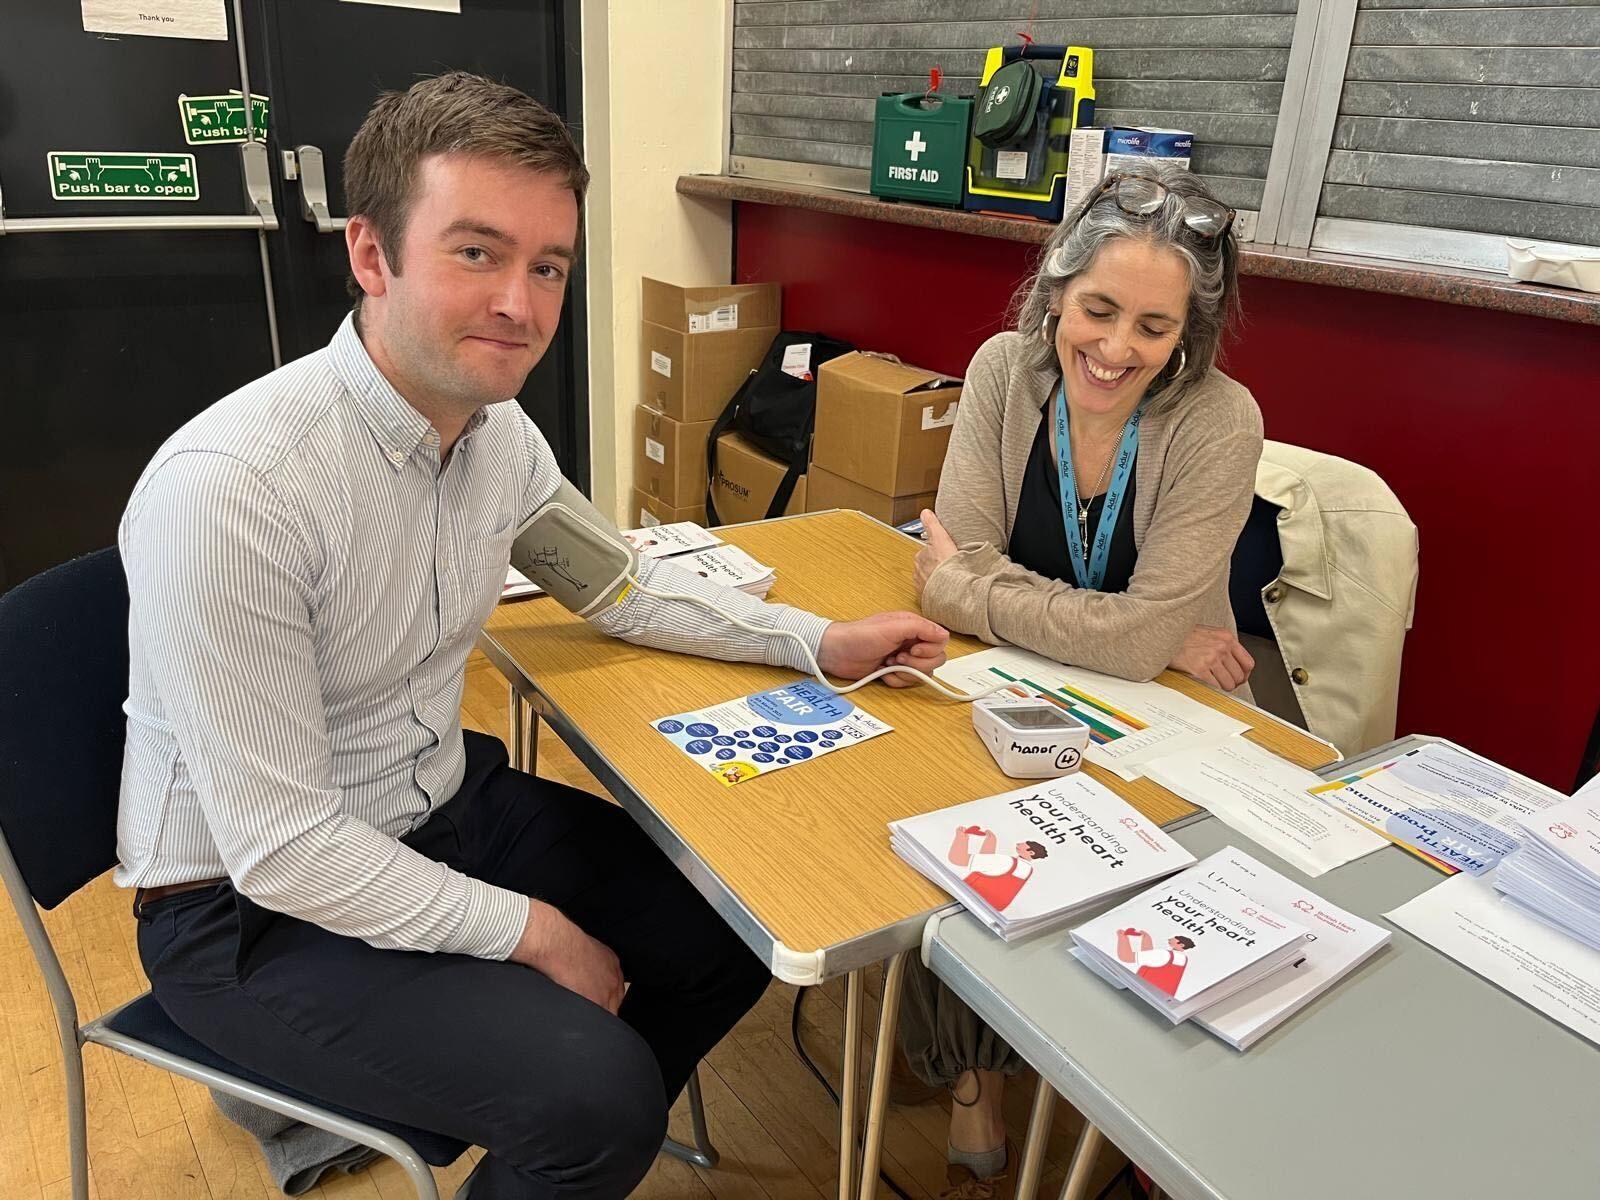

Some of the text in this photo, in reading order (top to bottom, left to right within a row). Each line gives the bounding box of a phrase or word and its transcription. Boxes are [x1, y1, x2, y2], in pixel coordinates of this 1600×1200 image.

[138, 14, 160, 22] Thank
[192, 126, 230, 138] Push
[1117, 137, 1140, 146] microlife
[888, 166, 939, 182] FIRST AID
[59, 183, 193, 195] Push bar to open
[1061, 460, 1069, 478] Adur
[1119, 449, 1129, 470] Adur
[721, 479, 749, 498] PROSUM
[1108, 491, 1118, 510] Adur
[1096, 532, 1106, 550] Adur
[694, 554, 718, 574] health
[720, 564, 743, 580] heart
[769, 689, 814, 716] FAIR
[788, 684, 842, 717] HEALTH
[1474, 788, 1498, 799] Health
[1341, 786, 1438, 836] Programme
[1507, 803, 1527, 812] Talks
[1009, 798, 1066, 845] health
[1047, 788, 1128, 854] Understanding
[1028, 793, 1125, 870] your heart
[1414, 834, 1484, 868] HEALTH
[1439, 835, 1494, 863] FAIR
[1152, 901, 1205, 936] health
[1163, 896, 1256, 947] your heart
[1178, 890, 1256, 936] Understanding
[1314, 913, 1349, 933] Foundation
[1318, 911, 1356, 932] British Heart
